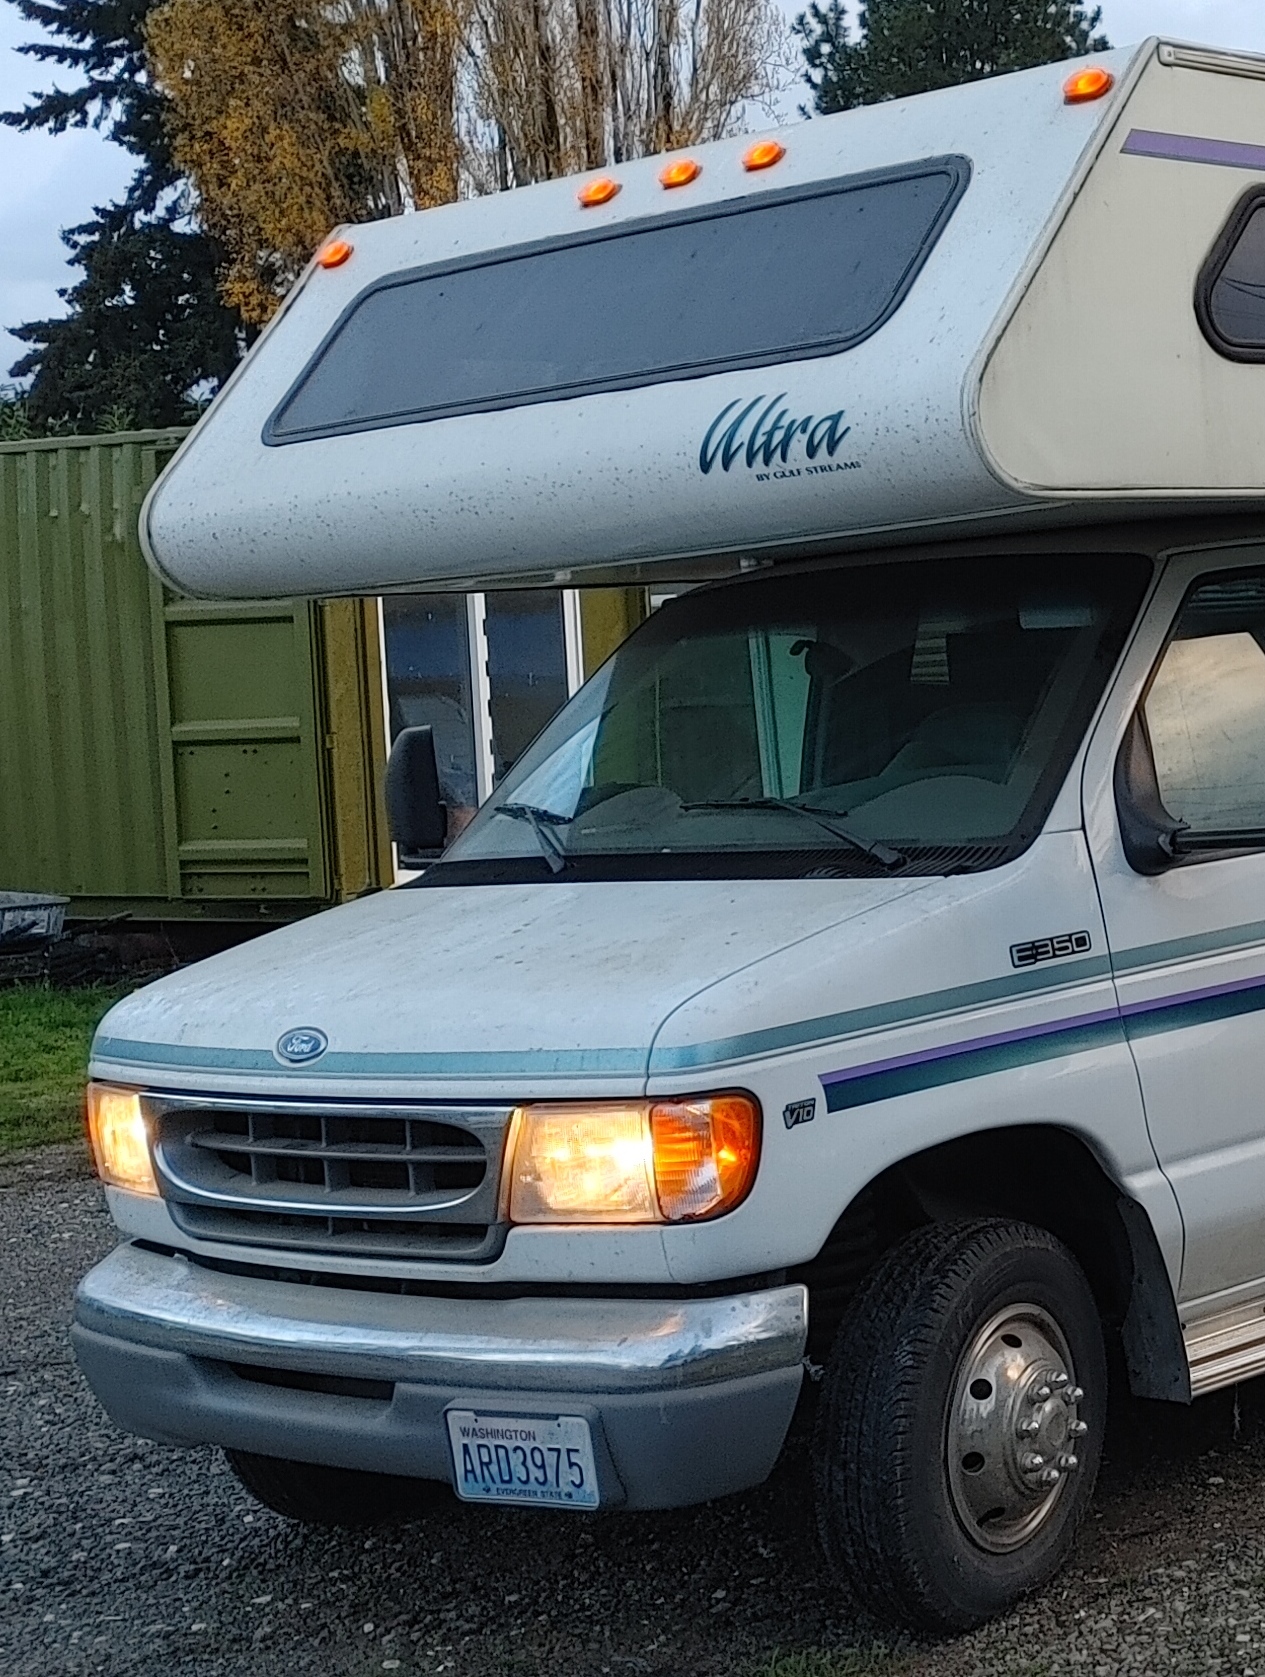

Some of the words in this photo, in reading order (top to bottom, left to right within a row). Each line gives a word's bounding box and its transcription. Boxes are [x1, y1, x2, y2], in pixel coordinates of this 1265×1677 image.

[699, 391, 851, 475] Ultra
[755, 473, 771, 482] BY
[773, 468, 802, 479] GULF
[287, 1035, 315, 1053] Ford
[784, 1106, 814, 1129] V10
[460, 1427, 536, 1442] WASHINGTON
[462, 1443, 584, 1489] ARD3975
